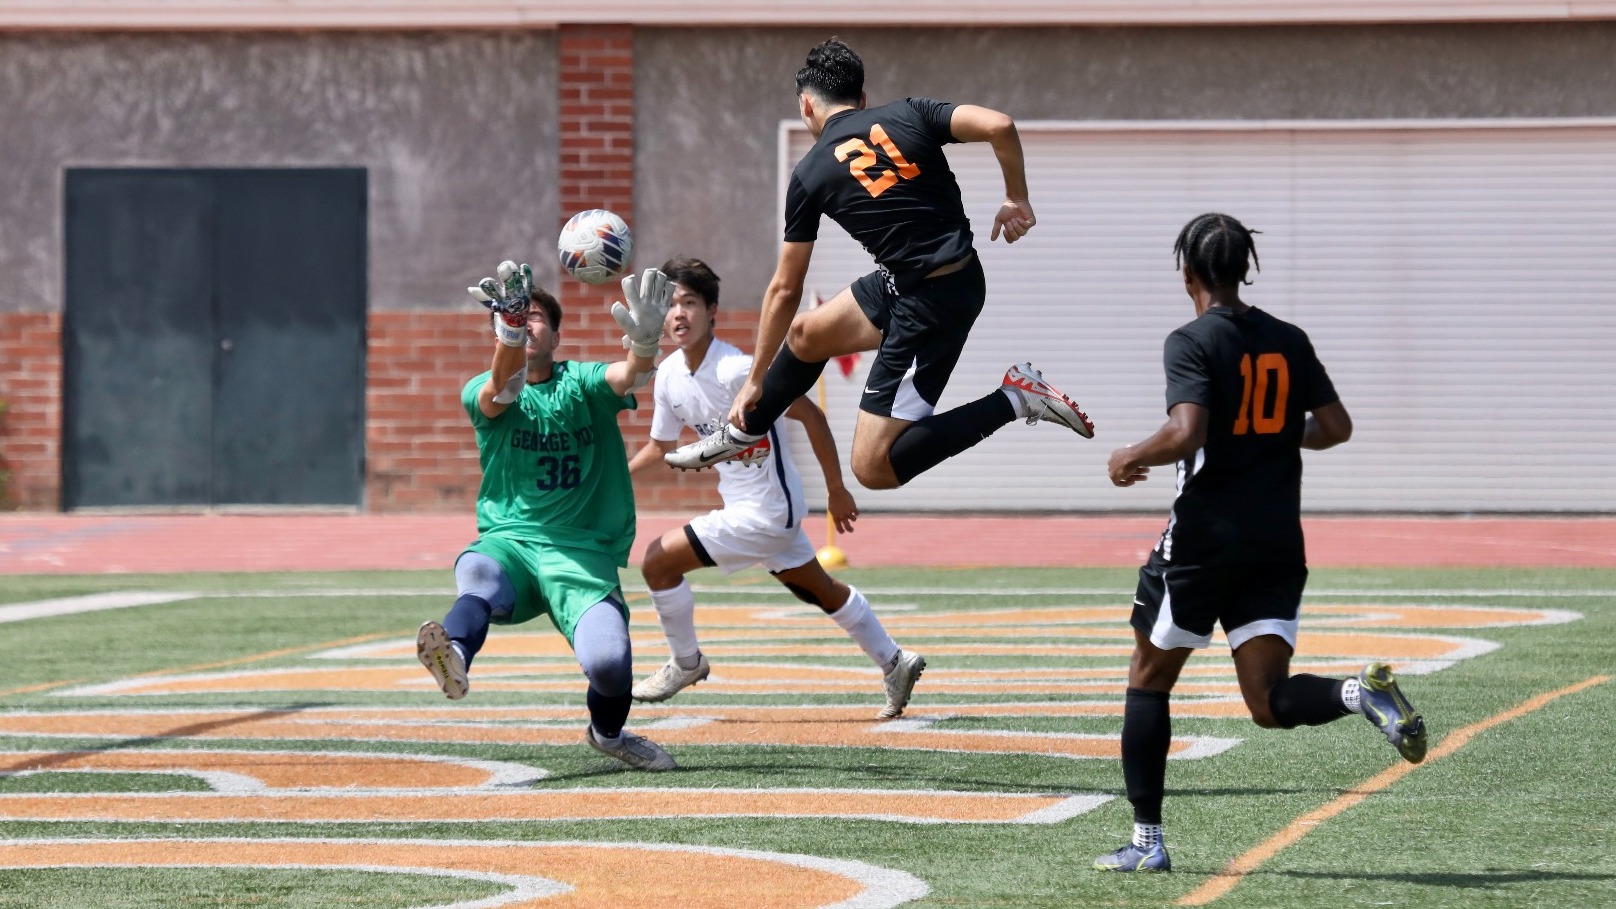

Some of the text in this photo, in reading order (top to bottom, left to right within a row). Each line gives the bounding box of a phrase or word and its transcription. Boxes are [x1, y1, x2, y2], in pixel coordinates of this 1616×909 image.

[834, 123, 921, 198] 21
[1232, 353, 1289, 435] 10
[511, 428, 571, 452] GEORGE
[536, 454, 581, 491] 36
